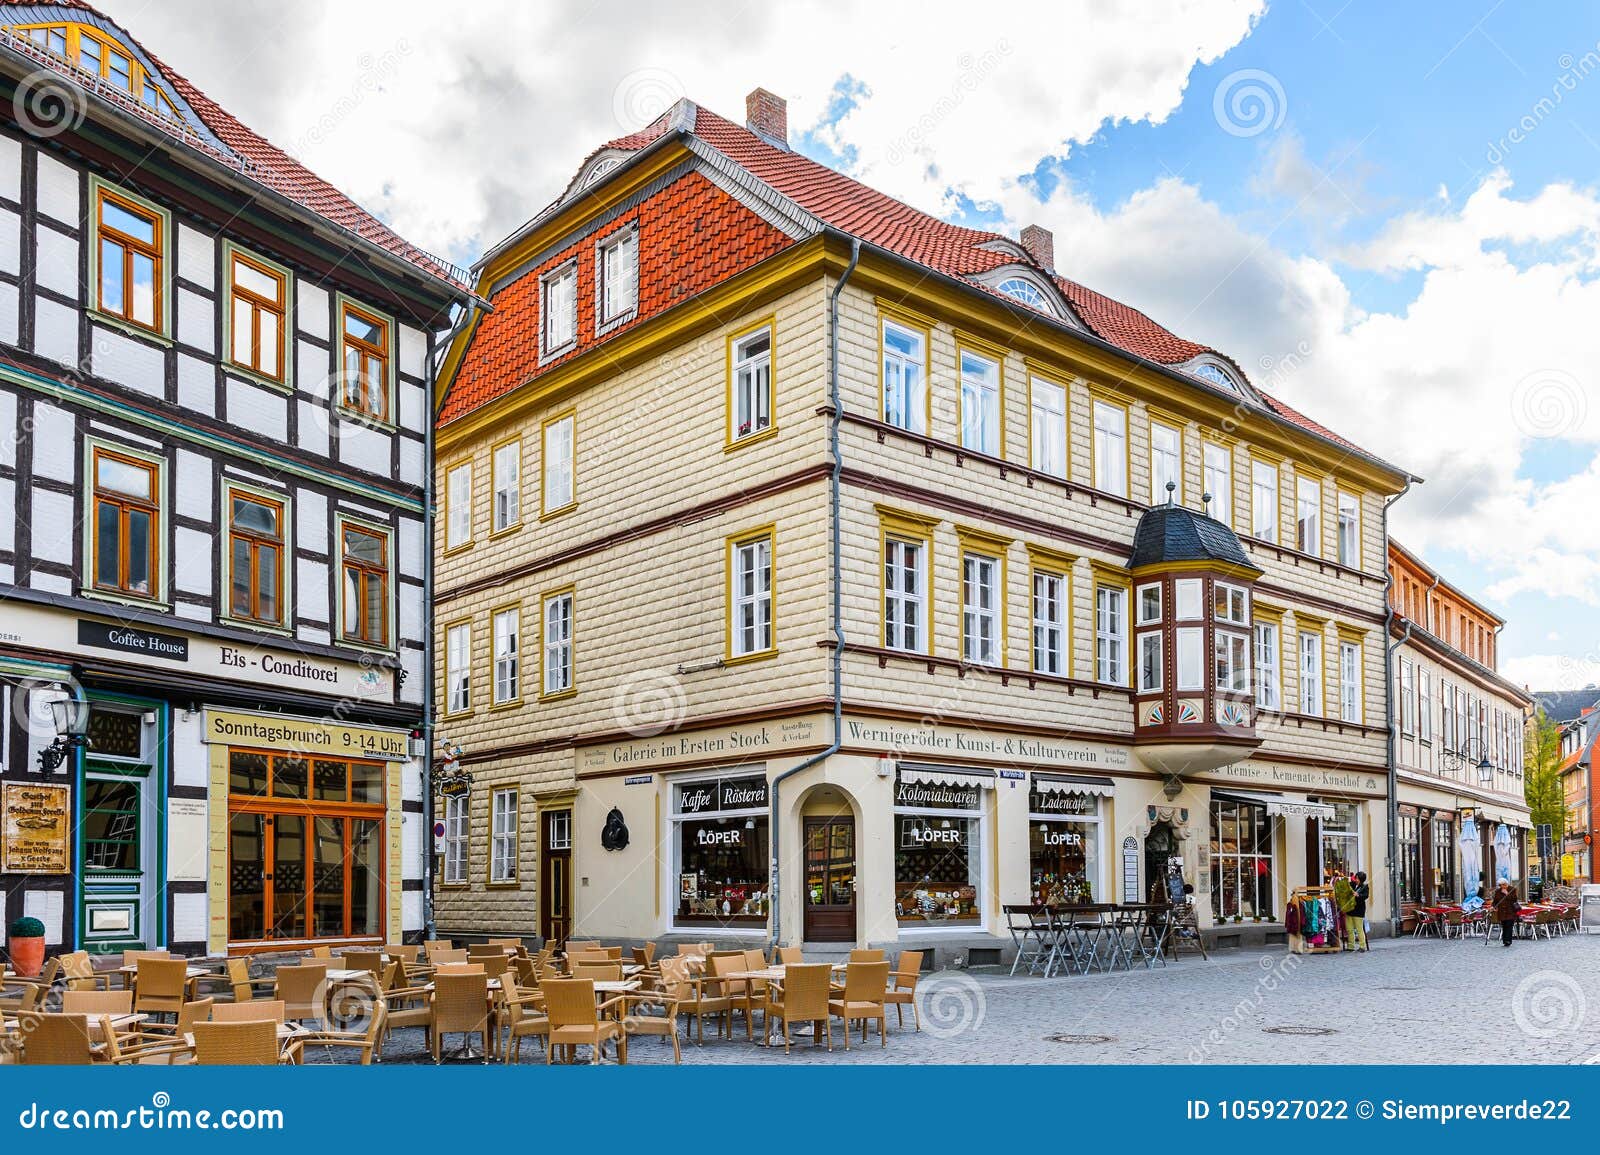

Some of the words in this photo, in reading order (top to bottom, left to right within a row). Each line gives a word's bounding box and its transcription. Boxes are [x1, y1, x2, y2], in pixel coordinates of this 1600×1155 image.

[108, 630, 145, 648] Coffee
[148, 636, 185, 655] House
[219, 646, 246, 668] Eis
[261, 654, 338, 683] Conditorei
[214, 718, 331, 746] Sonntagsbrunch
[380, 736, 404, 753] Uhr
[613, 743, 657, 763] Galerie
[661, 742, 676, 757] im
[679, 737, 724, 755] Ersten
[729, 727, 770, 749] Stock
[848, 720, 952, 749] Wernigeröder
[956, 733, 1001, 753] Kunst-
[1003, 738, 1015, 755] &
[1019, 739, 1097, 763] Kulturverein
[1226, 763, 1261, 778] Remise
[1272, 766, 1316, 783] Kemenate
[1321, 771, 1361, 789] Kunsthof
[680, 789, 711, 812] Kaffee
[723, 785, 765, 804] Rösterei
[896, 784, 978, 805] Kolonialwaren
[1279, 804, 1289, 813] The
[1289, 806, 1302, 815] Earth
[1303, 807, 1325, 816] Collection
[699, 830, 740, 845] LÖPER
[915, 828, 960, 843] LÖPER
[1044, 831, 1081, 846] LÖPER
